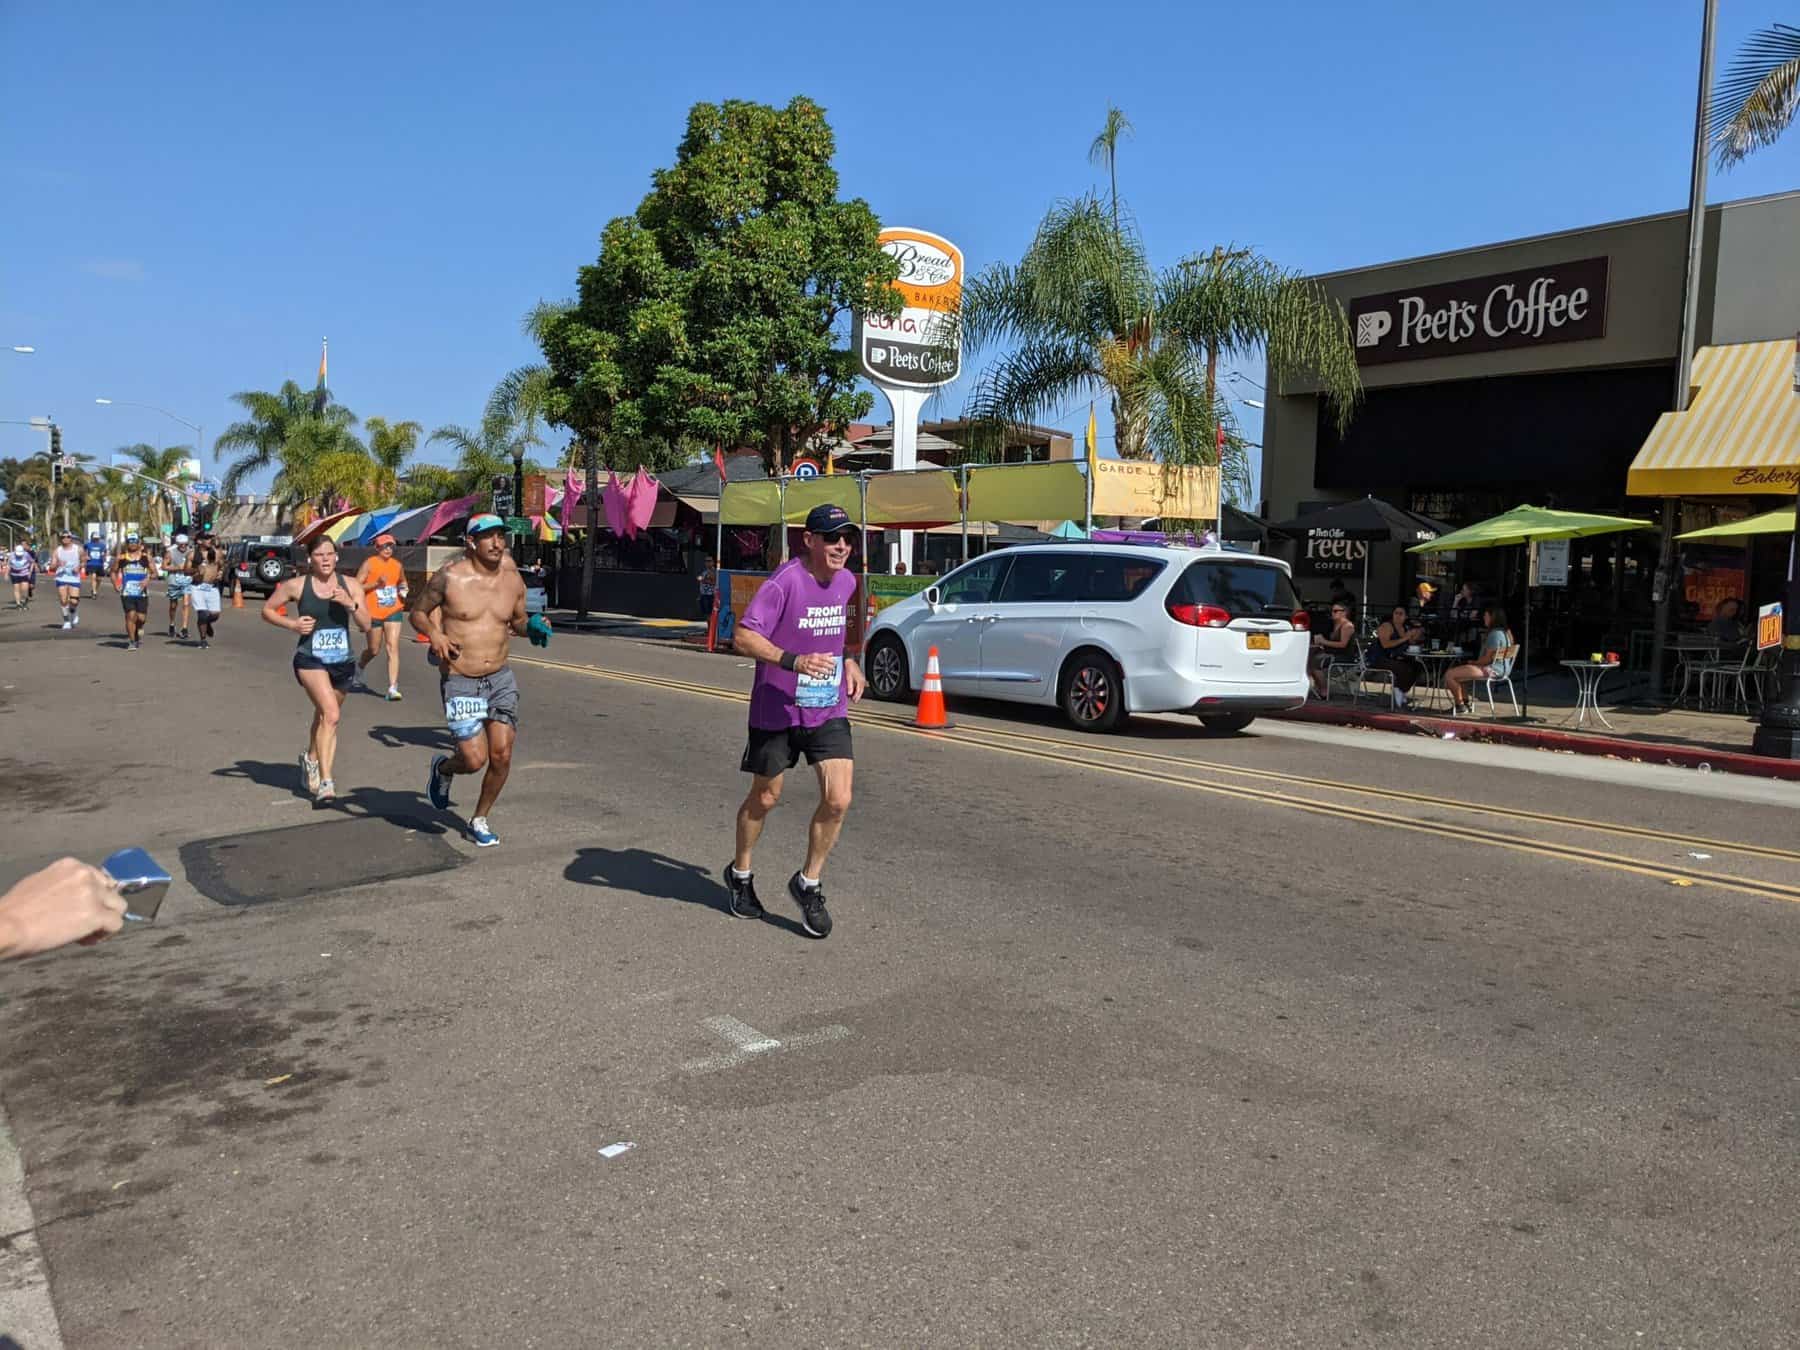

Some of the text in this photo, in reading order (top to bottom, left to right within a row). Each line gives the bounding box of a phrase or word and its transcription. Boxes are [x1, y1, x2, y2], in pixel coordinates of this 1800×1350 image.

[886, 242, 952, 277] Bread
[1397, 278, 1589, 347] Peet's Coffee
[921, 352, 954, 374] Coffee
[1733, 467, 1800, 488] Bakery
[807, 606, 842, 617] FRONT
[1760, 616, 1780, 645] OPEN
